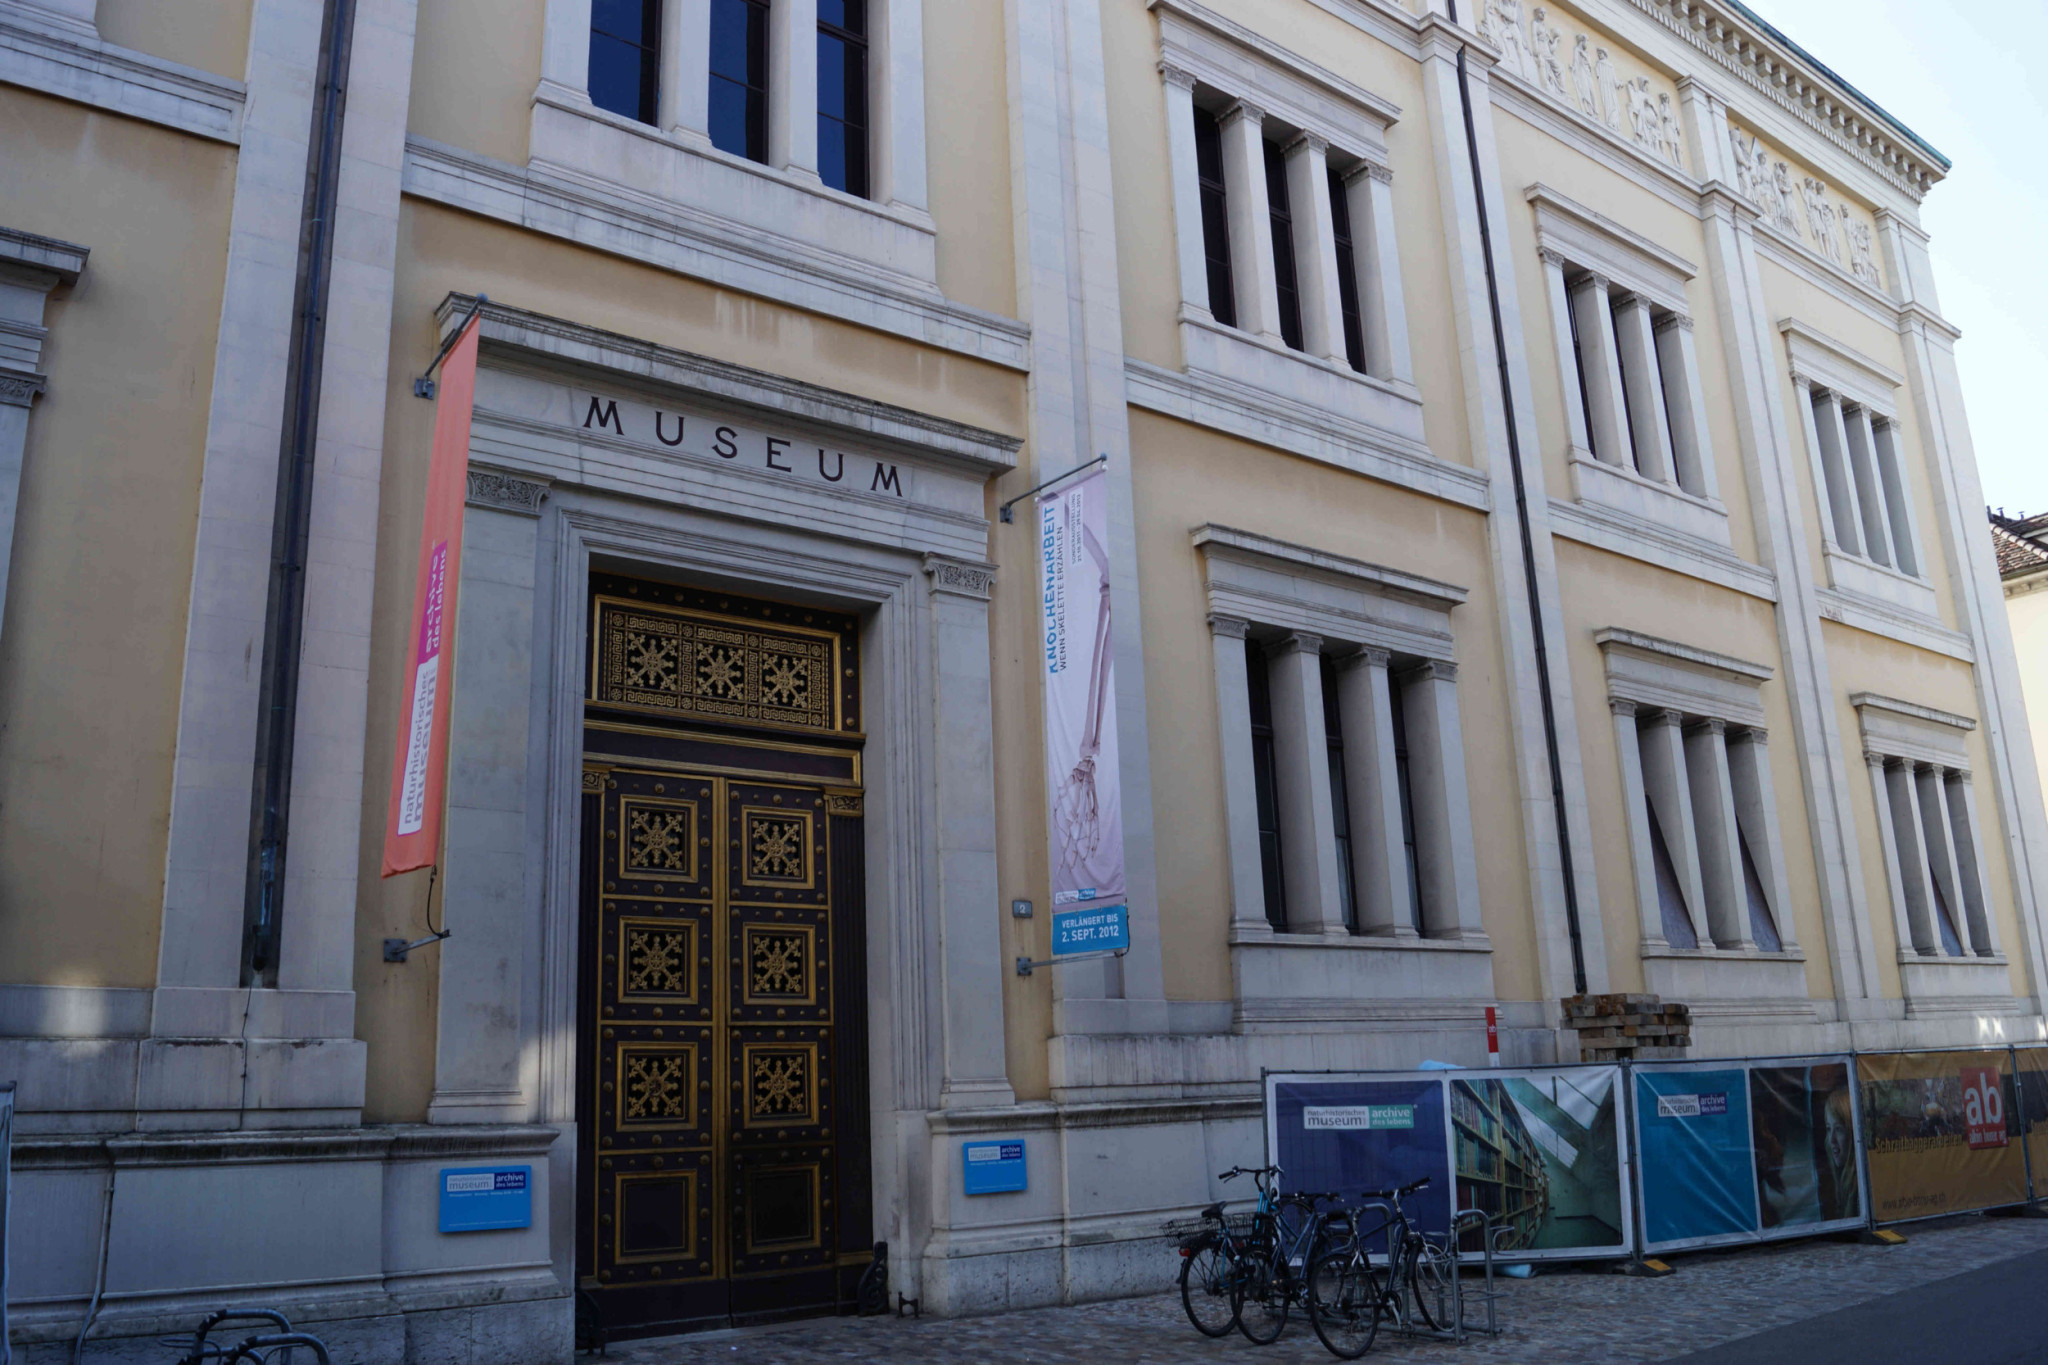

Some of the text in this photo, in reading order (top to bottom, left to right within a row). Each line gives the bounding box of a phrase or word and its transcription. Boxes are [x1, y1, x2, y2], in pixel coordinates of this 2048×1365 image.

[583, 396, 903, 498] MUSEUM
[434, 549, 446, 619] lebens
[1043, 506, 1058, 674] KNOCHENARBEIT
[1056, 526, 1067, 671] WENN SKELETTE ERZÄHLEN
[425, 554, 438, 653] archive
[404, 672, 429, 825] naturhistorisches
[413, 676, 436, 822] museum
[1062, 913, 1118, 929] VERLÄNGERT BIS
[1062, 925, 1119, 943] 2. SEPT. 2012
[1372, 1106, 1410, 1118] archive
[1700, 1094, 1725, 1104] archive
[1965, 1072, 2002, 1126] ab
[1308, 1117, 1362, 1126] museum
[1001, 1145, 1021, 1153] archive
[449, 1181, 489, 1190] museum
[496, 1173, 524, 1182] archive
